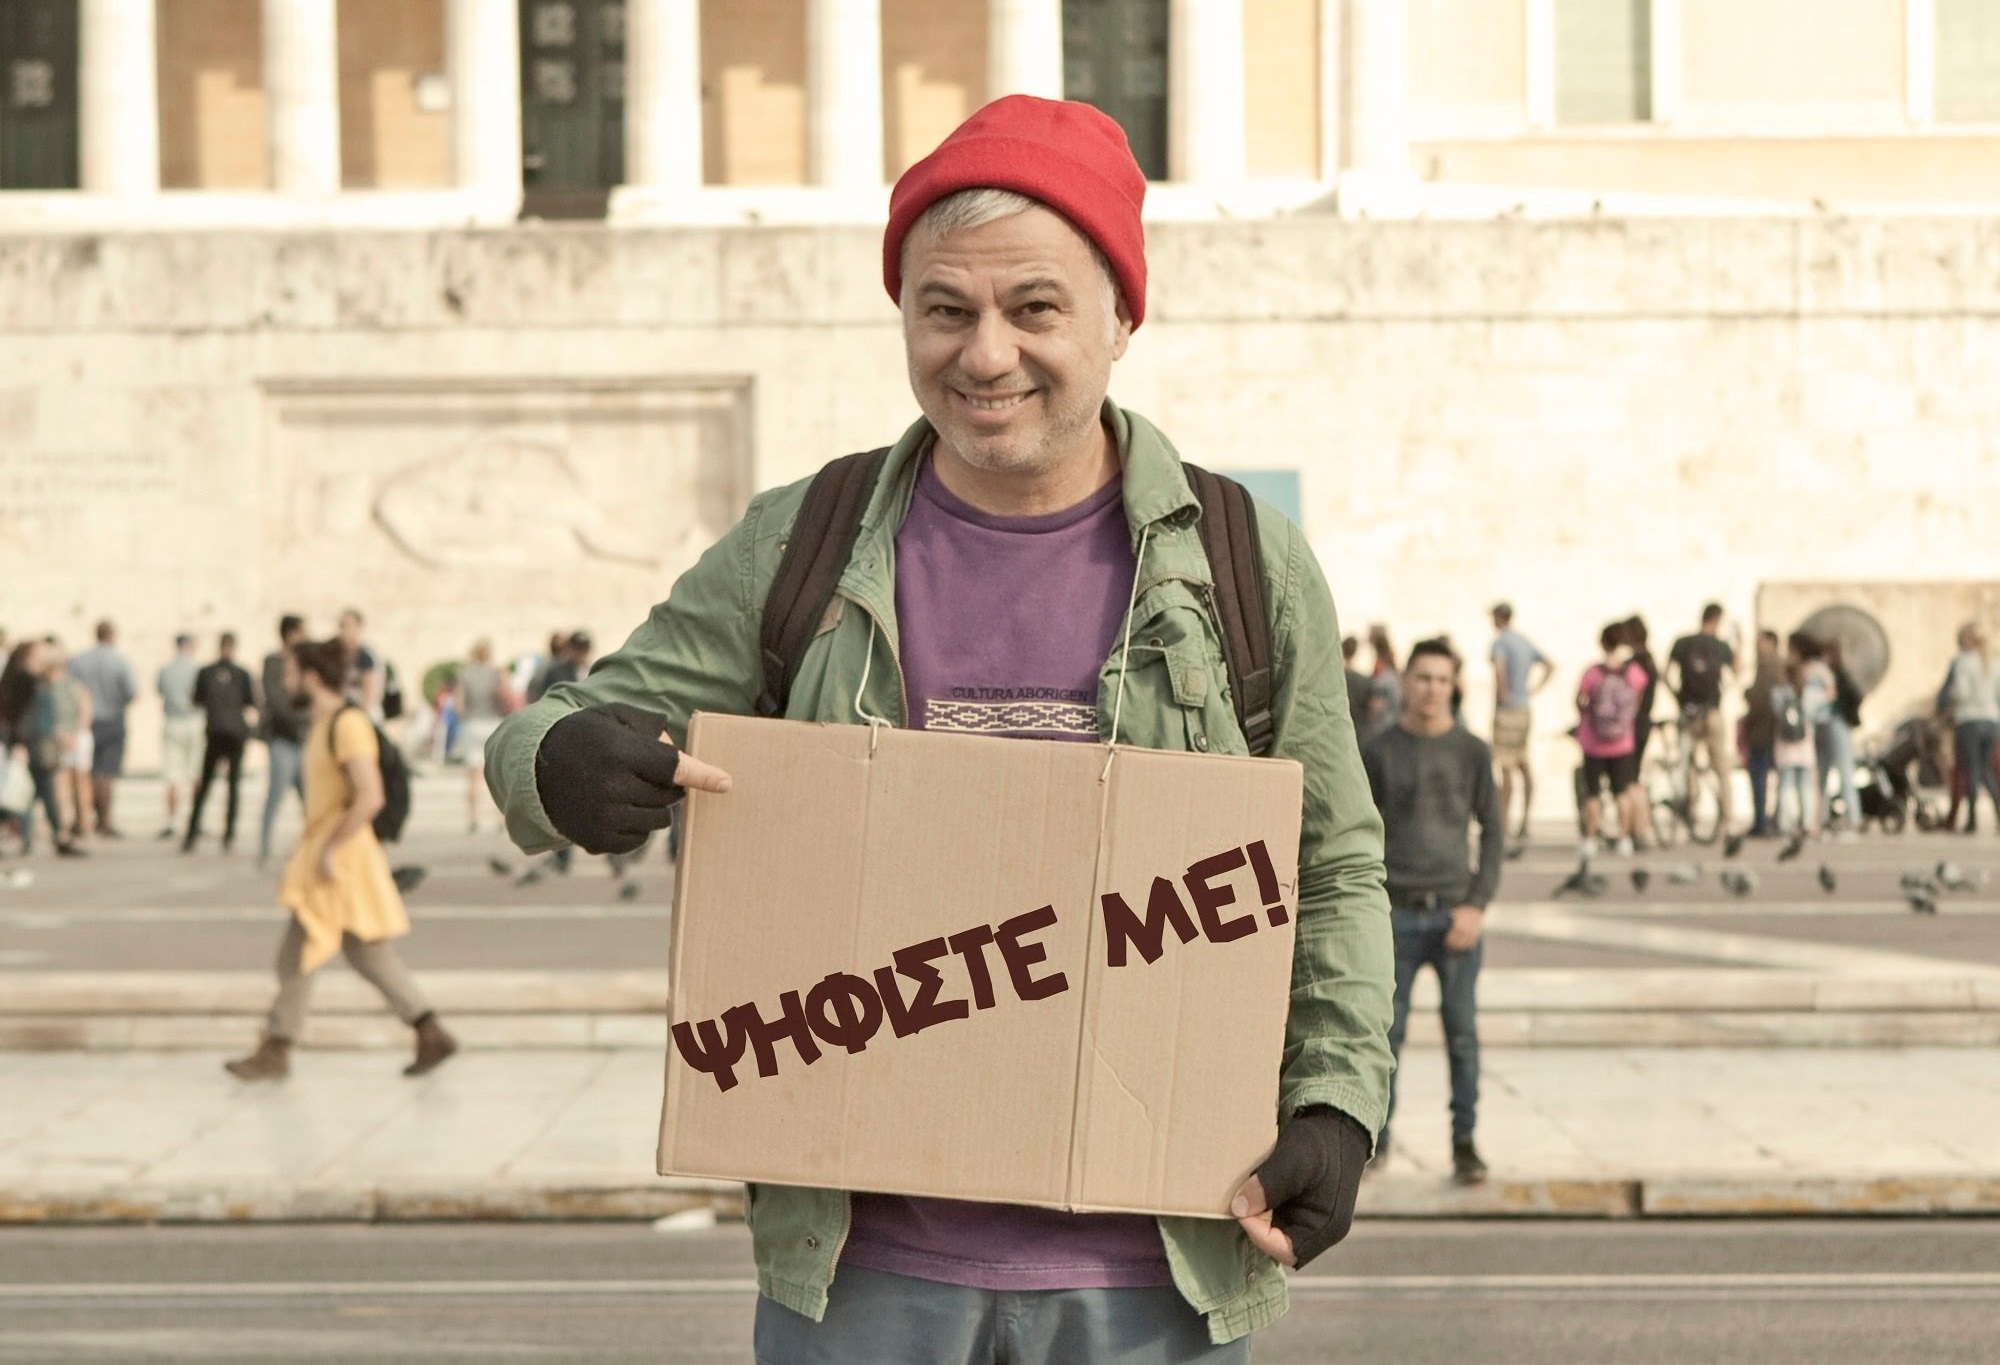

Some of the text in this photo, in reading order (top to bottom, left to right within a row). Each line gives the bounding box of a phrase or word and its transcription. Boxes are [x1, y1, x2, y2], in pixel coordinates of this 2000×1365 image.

[952, 686, 1088, 702] CULTURA ABORIGEN
[671, 839, 1290, 1093] ΨΗΦΙΣΤΕ ΜΕ!
